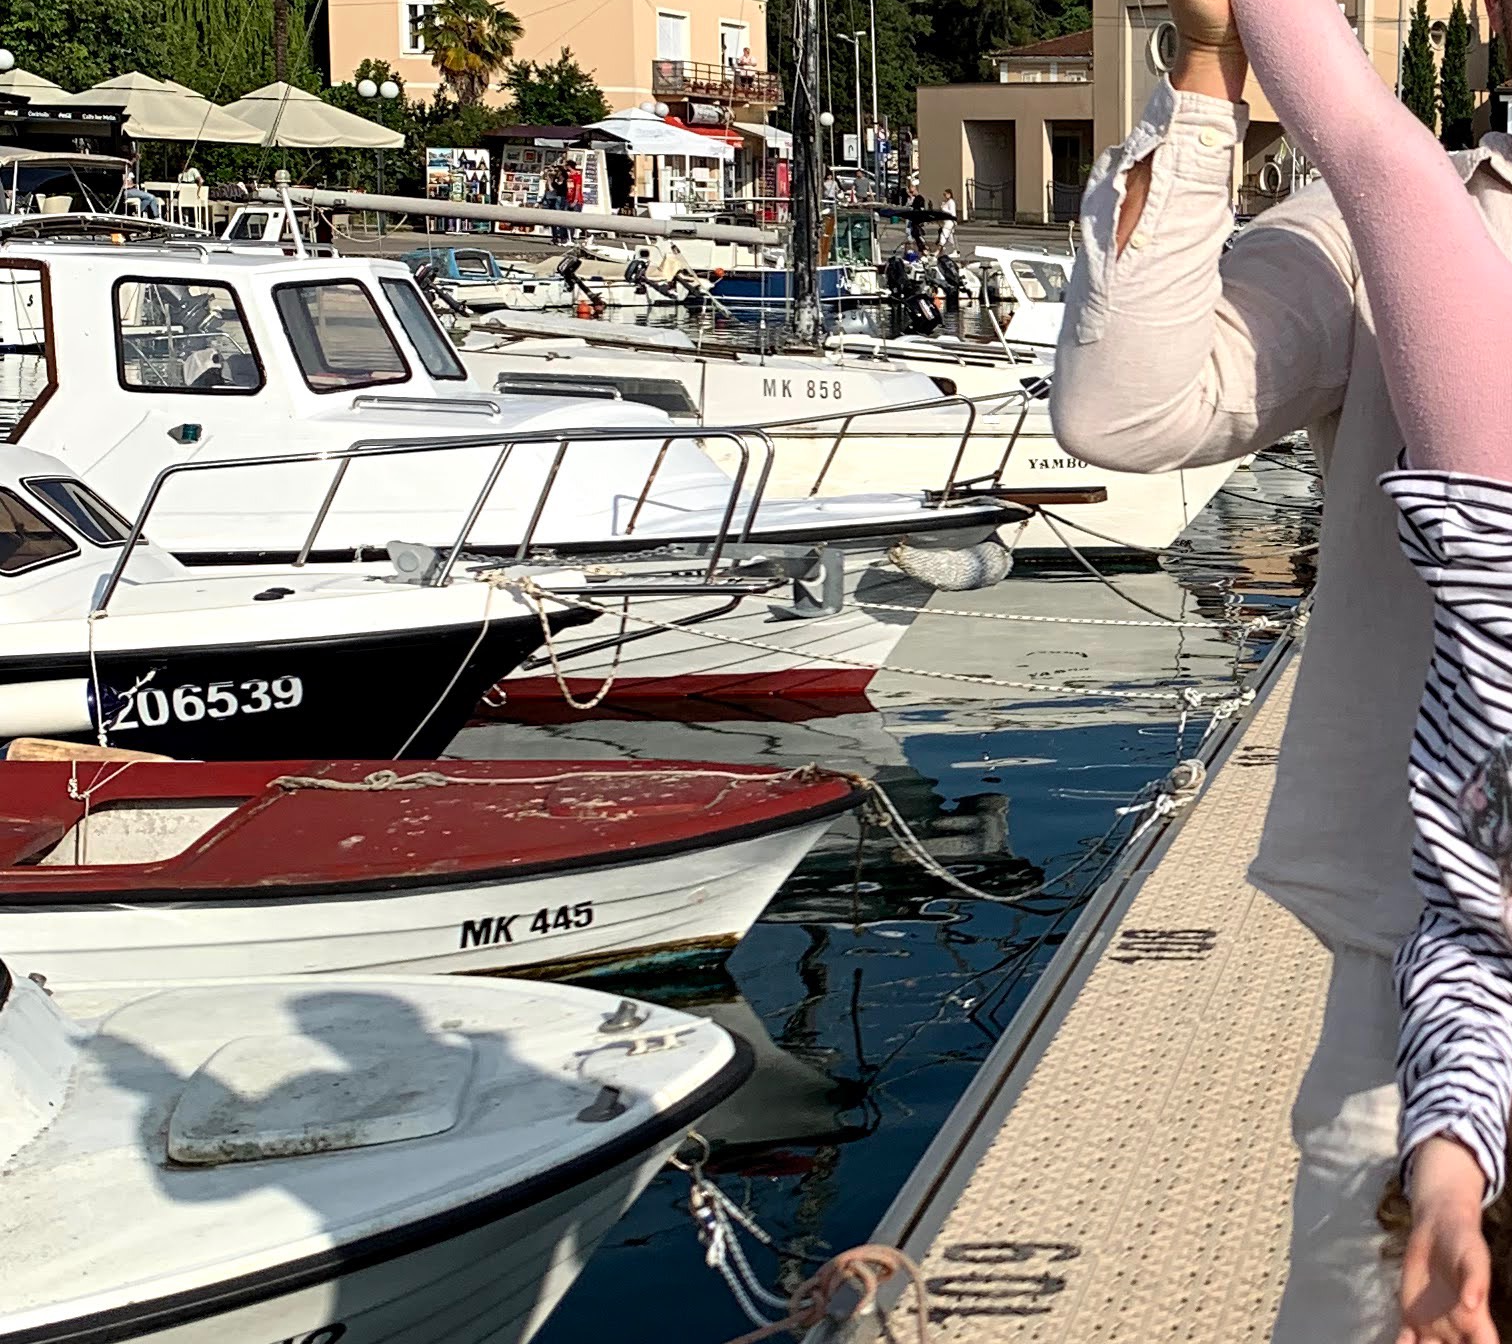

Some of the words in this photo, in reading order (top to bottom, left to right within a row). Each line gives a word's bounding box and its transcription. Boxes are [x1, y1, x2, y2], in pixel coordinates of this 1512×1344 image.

[763, 379, 792, 397] MK
[806, 380, 842, 399] 858
[1028, 458, 1088, 469] YAMBO
[110, 675, 303, 732] 206539
[460, 914, 520, 948] MK
[530, 900, 594, 934] 445
